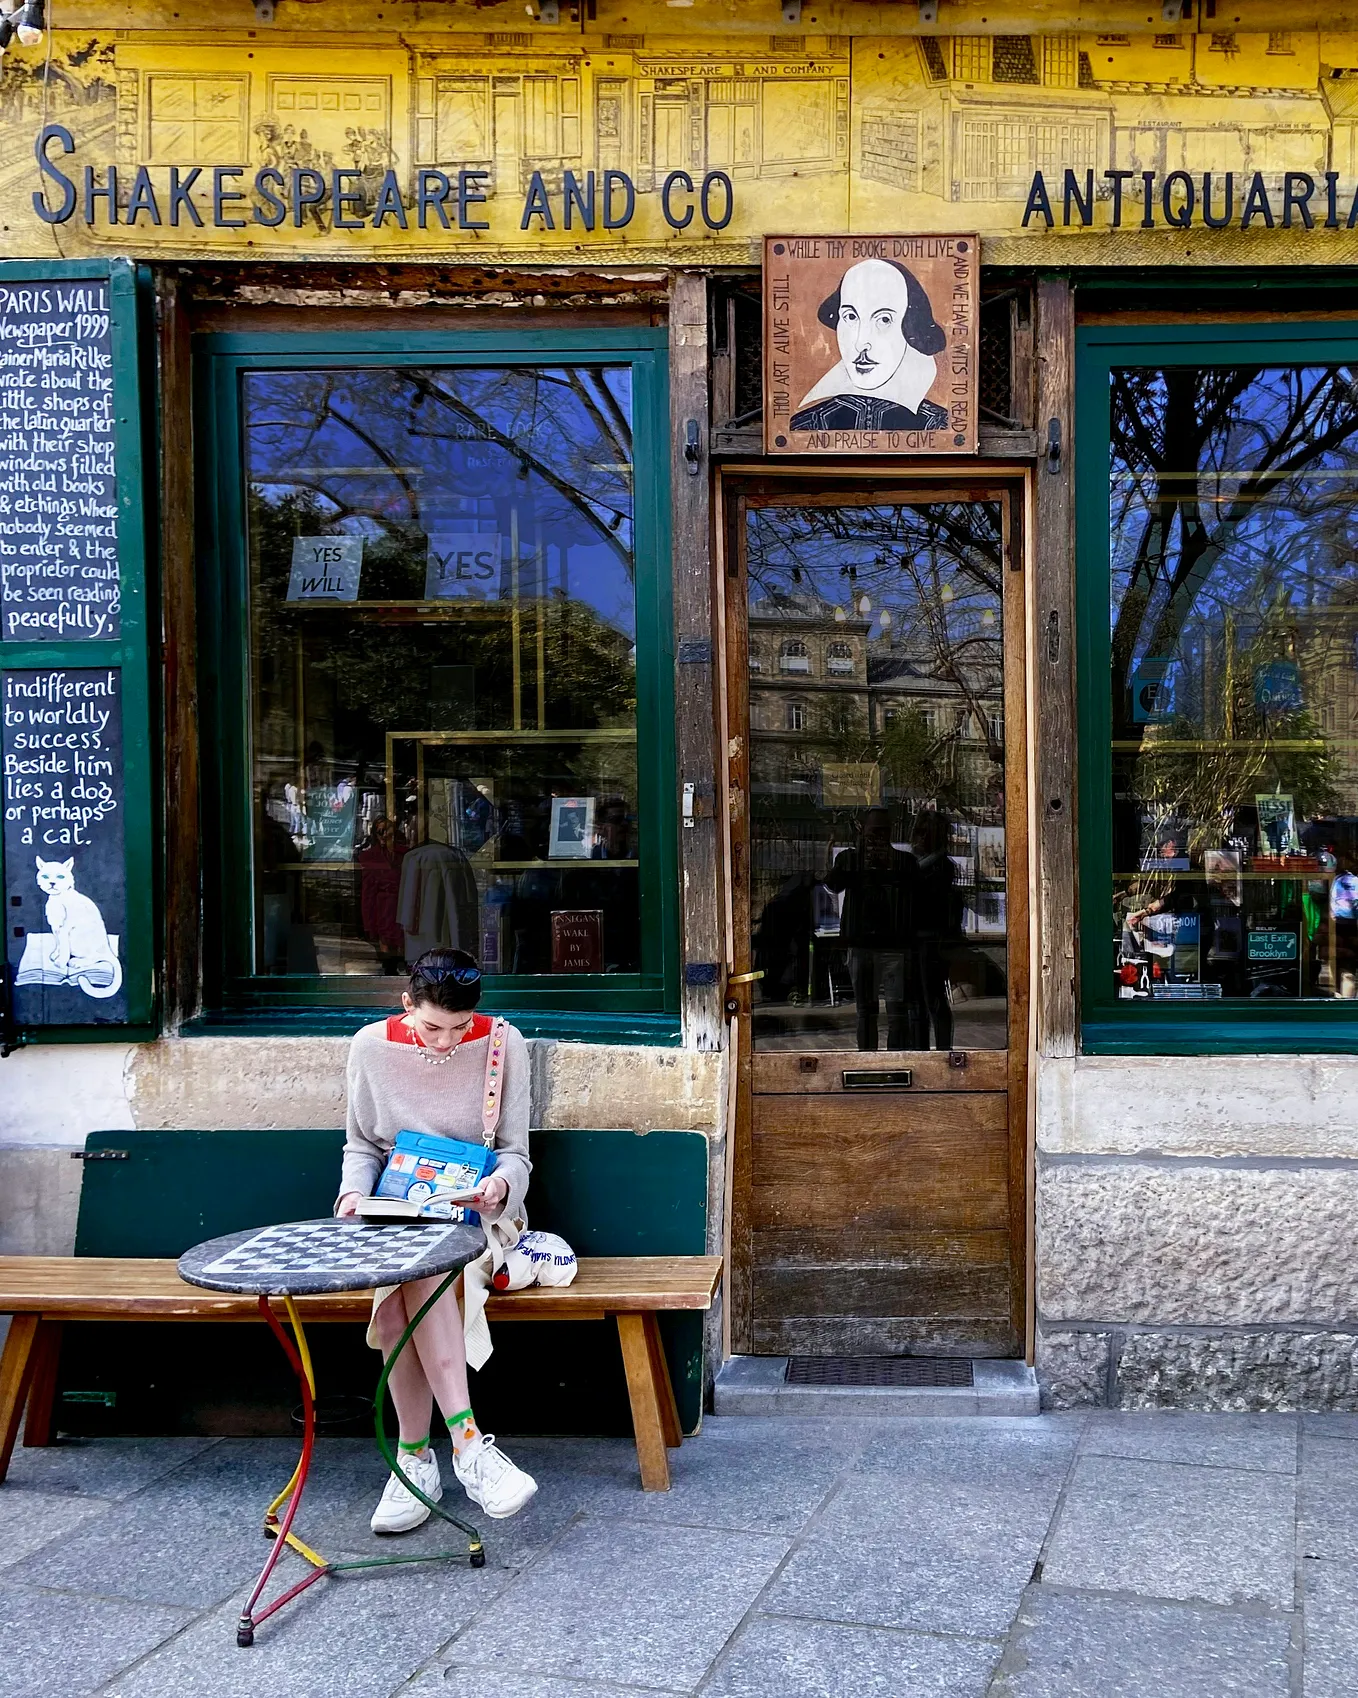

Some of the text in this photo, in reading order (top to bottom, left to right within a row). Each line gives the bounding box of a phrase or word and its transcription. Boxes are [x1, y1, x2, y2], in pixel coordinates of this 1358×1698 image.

[639, 65, 834, 76] SHAKESPEARE AND COMPANY
[33, 124, 734, 231] SHAKESPEARE AND CO
[788, 239, 955, 259] WHILE THY BOOKE DOTH LIVE
[0, 288, 110, 314] PARIS WALL
[75, 314, 109, 340] 1999
[774, 275, 790, 419] THOU ART ALIVE STILL
[951, 256, 969, 432] AND WE HAVE WITS TO READ
[0, 346, 112, 369] ainer Maria Rilke
[41, 371, 83, 390] about
[87, 371, 113, 391] the
[0, 389, 113, 419] ittle shops of
[23, 410, 59, 431] latin
[60, 412, 115, 439] quarter
[0, 431, 115, 461] with their shop
[806, 431, 936, 449] AND PRAISE TO GIVE
[0, 452, 116, 480] windows filled
[0, 472, 105, 495] with old books
[0, 494, 119, 521] & etchings. Where
[0, 514, 118, 541] nobody seemed
[0, 536, 116, 560] to enter & the
[312, 547, 342, 563] YES
[1, 558, 121, 585] proprietor could
[323, 562, 328, 577] I
[432, 551, 495, 579] YES
[301, 577, 344, 592] WILL
[3, 582, 121, 614] be seen reading
[8, 602, 113, 638] peacefully,
[7, 672, 116, 702] indifferent
[5, 702, 110, 732] to worldly
[14, 732, 110, 751] success.
[4, 751, 113, 776] Beside him
[7, 777, 117, 812] lies a dog
[5, 800, 104, 827] or perhaps
[21, 823, 92, 845] a cat.
[563, 929, 589, 937] WAKE
[1250, 934, 1287, 942] Last Exit
[570, 943, 581, 952] BY
[1249, 949, 1287, 959] Brooklyn
[1265, 942, 1274, 950] to
[563, 958, 591, 967] JAMES
